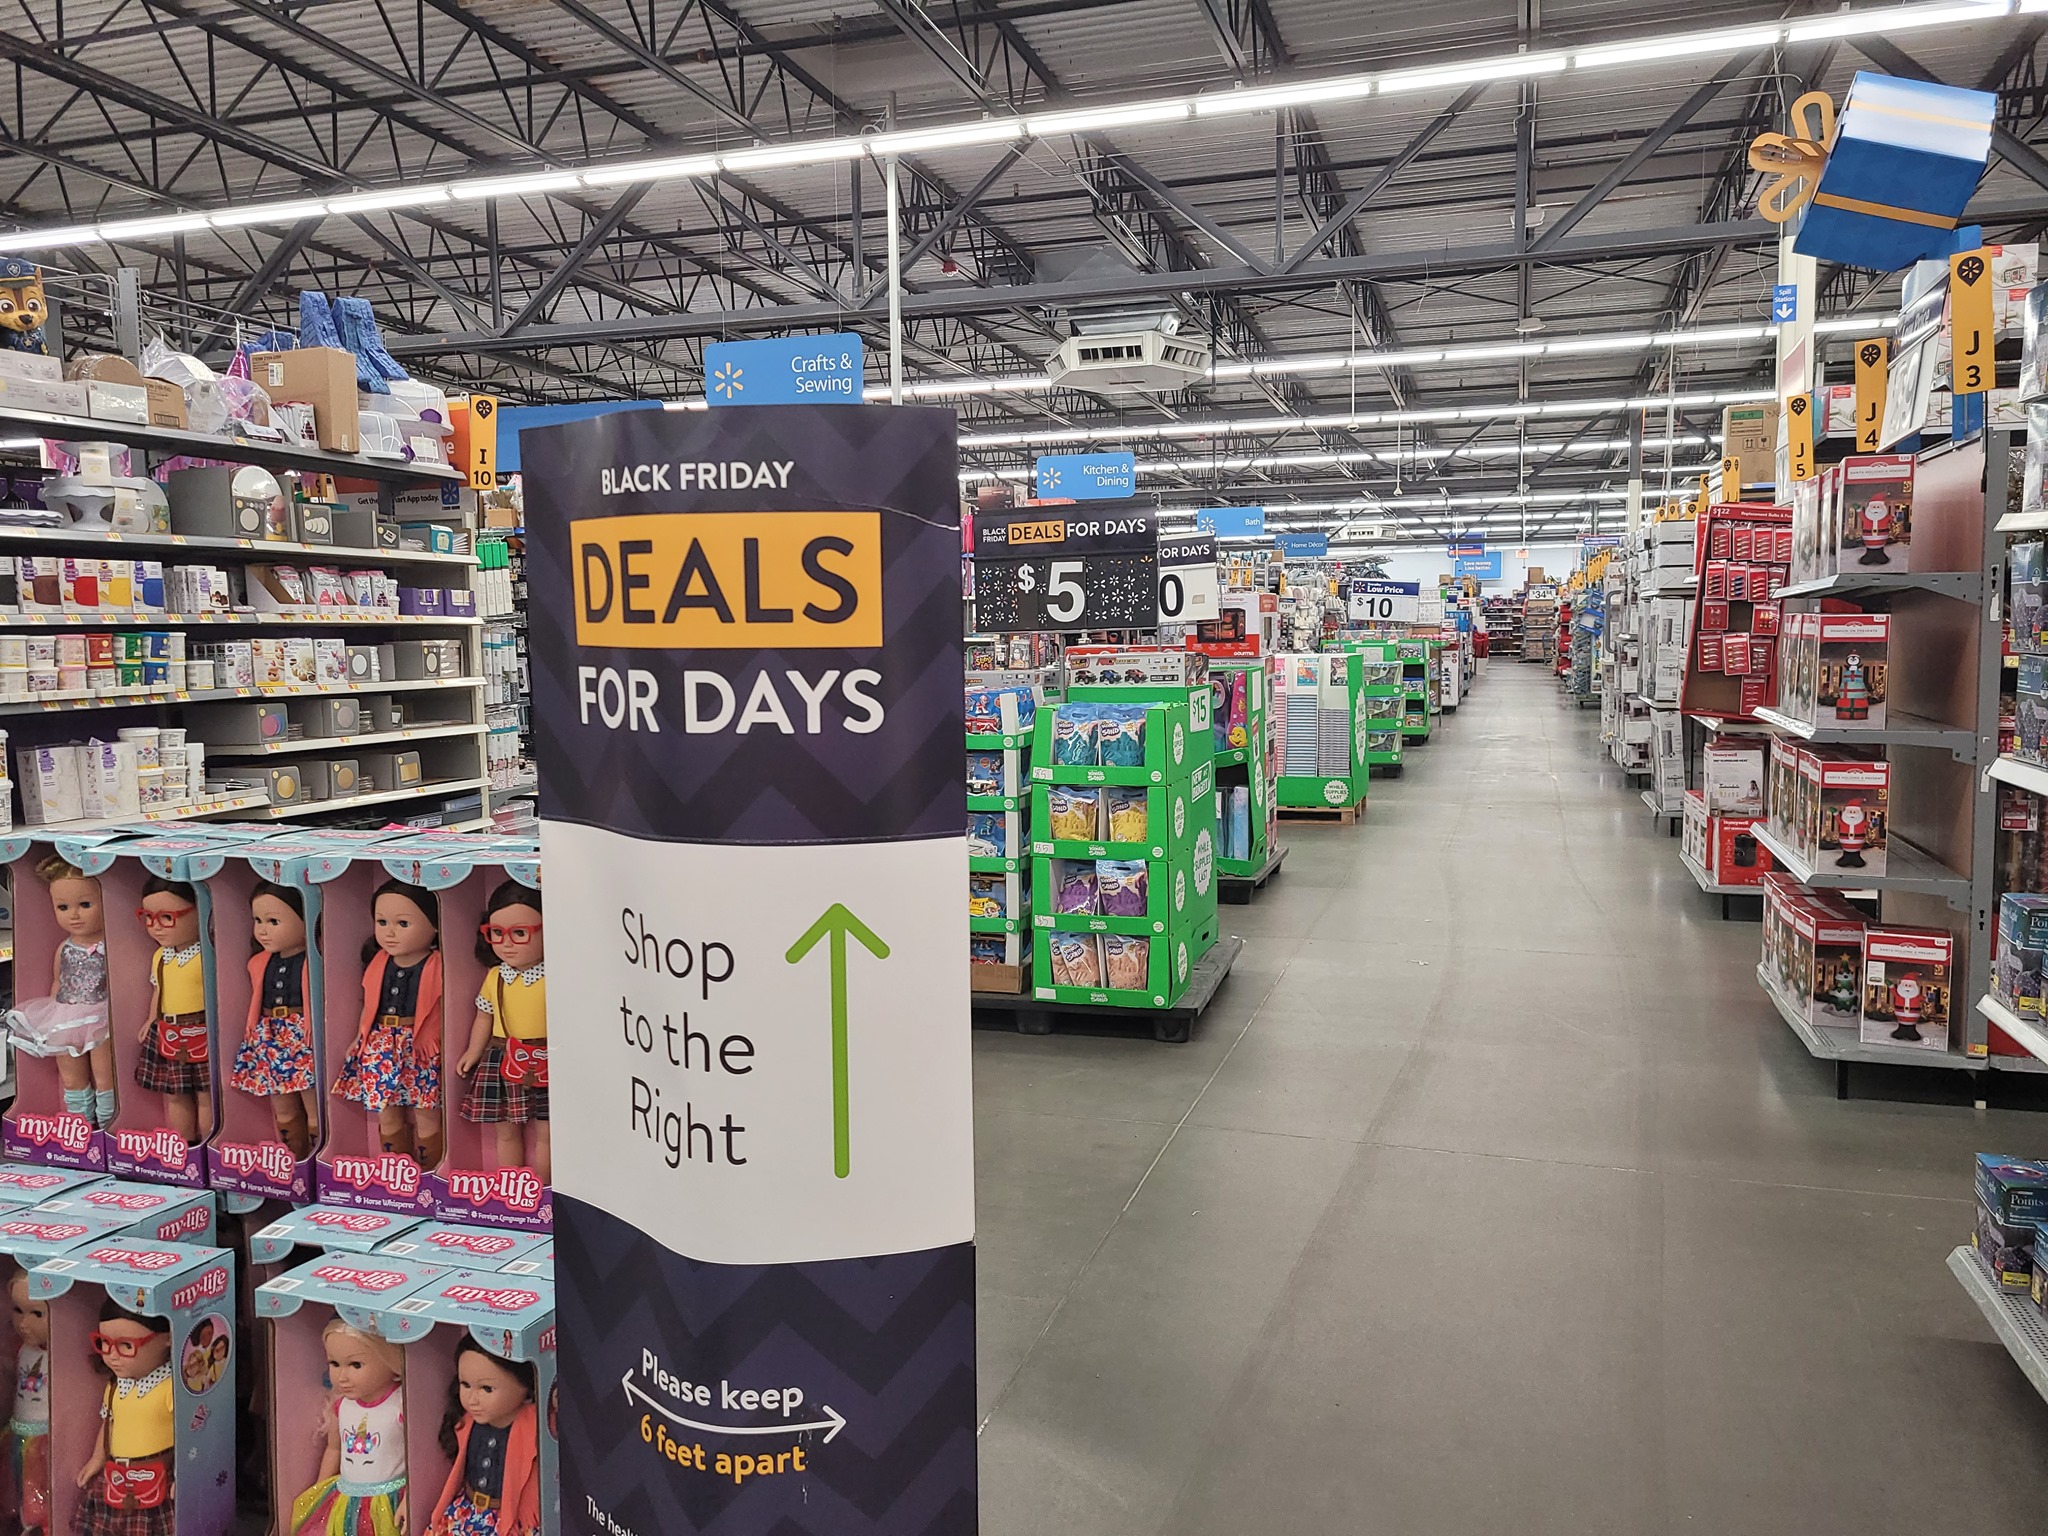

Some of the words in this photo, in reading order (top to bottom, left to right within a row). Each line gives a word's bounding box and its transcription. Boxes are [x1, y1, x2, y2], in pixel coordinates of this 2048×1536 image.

[1778, 288, 1792, 296] Spill
[1965, 330, 1980, 355] J
[791, 354, 835, 374] Crafts
[840, 353, 853, 370] &
[1965, 365, 1981, 387] 3
[796, 376, 853, 395] Sewing
[1865, 402, 1877, 422] J
[1864, 429, 1879, 446] 4
[1796, 443, 1804, 457] J
[1083, 465, 1119, 475] Kitchen
[1121, 464, 1129, 474] &
[1796, 464, 1806, 477] 5
[473, 470, 492, 486] 10
[601, 463, 671, 495] BLACK
[680, 461, 794, 491] FRIDAY
[1097, 476, 1129, 488] Dining
[1245, 517, 1260, 526] Bath
[1011, 524, 1061, 541] DEALS
[1067, 522, 1099, 538] FOR
[1105, 519, 1146, 535] DAYS
[983, 535, 1006, 543] FRIDAY
[1182, 544, 1210, 557] DAYS
[581, 536, 858, 624] DEALS
[1385, 586, 1404, 594] Price
[578, 666, 660, 733] FOR
[683, 669, 885, 735] DAYS
[622, 908, 735, 1000] Shop
[620, 996, 653, 1053] to
[663, 1011, 755, 1075] the
[631, 1076, 747, 1169] Right
[73, 1140, 84, 1149] as
[54, 1155, 79, 1163] Ballerina
[172, 1157, 182, 1165] as
[278, 1171, 289, 1180] as
[248, 1184, 262, 1192] Horse
[263, 1186, 291, 1197] Whisperer
[400, 1183, 413, 1192] as
[363, 1197, 381, 1206] Horse
[383, 1199, 415, 1210] Whisperer
[520, 1198, 534, 1207] as
[2011, 1194, 2044, 1208] Points
[478, 1212, 498, 1222] Foreign
[499, 1214, 526, 1224] Language
[526, 1216, 541, 1224] Tutor
[642, 1347, 711, 1406] Please
[721, 1380, 804, 1417] keep
[640, 1414, 653, 1443] 6
[656, 1425, 706, 1472] feet
[715, 1445, 806, 1485] apart
[586, 1495, 606, 1526] The
